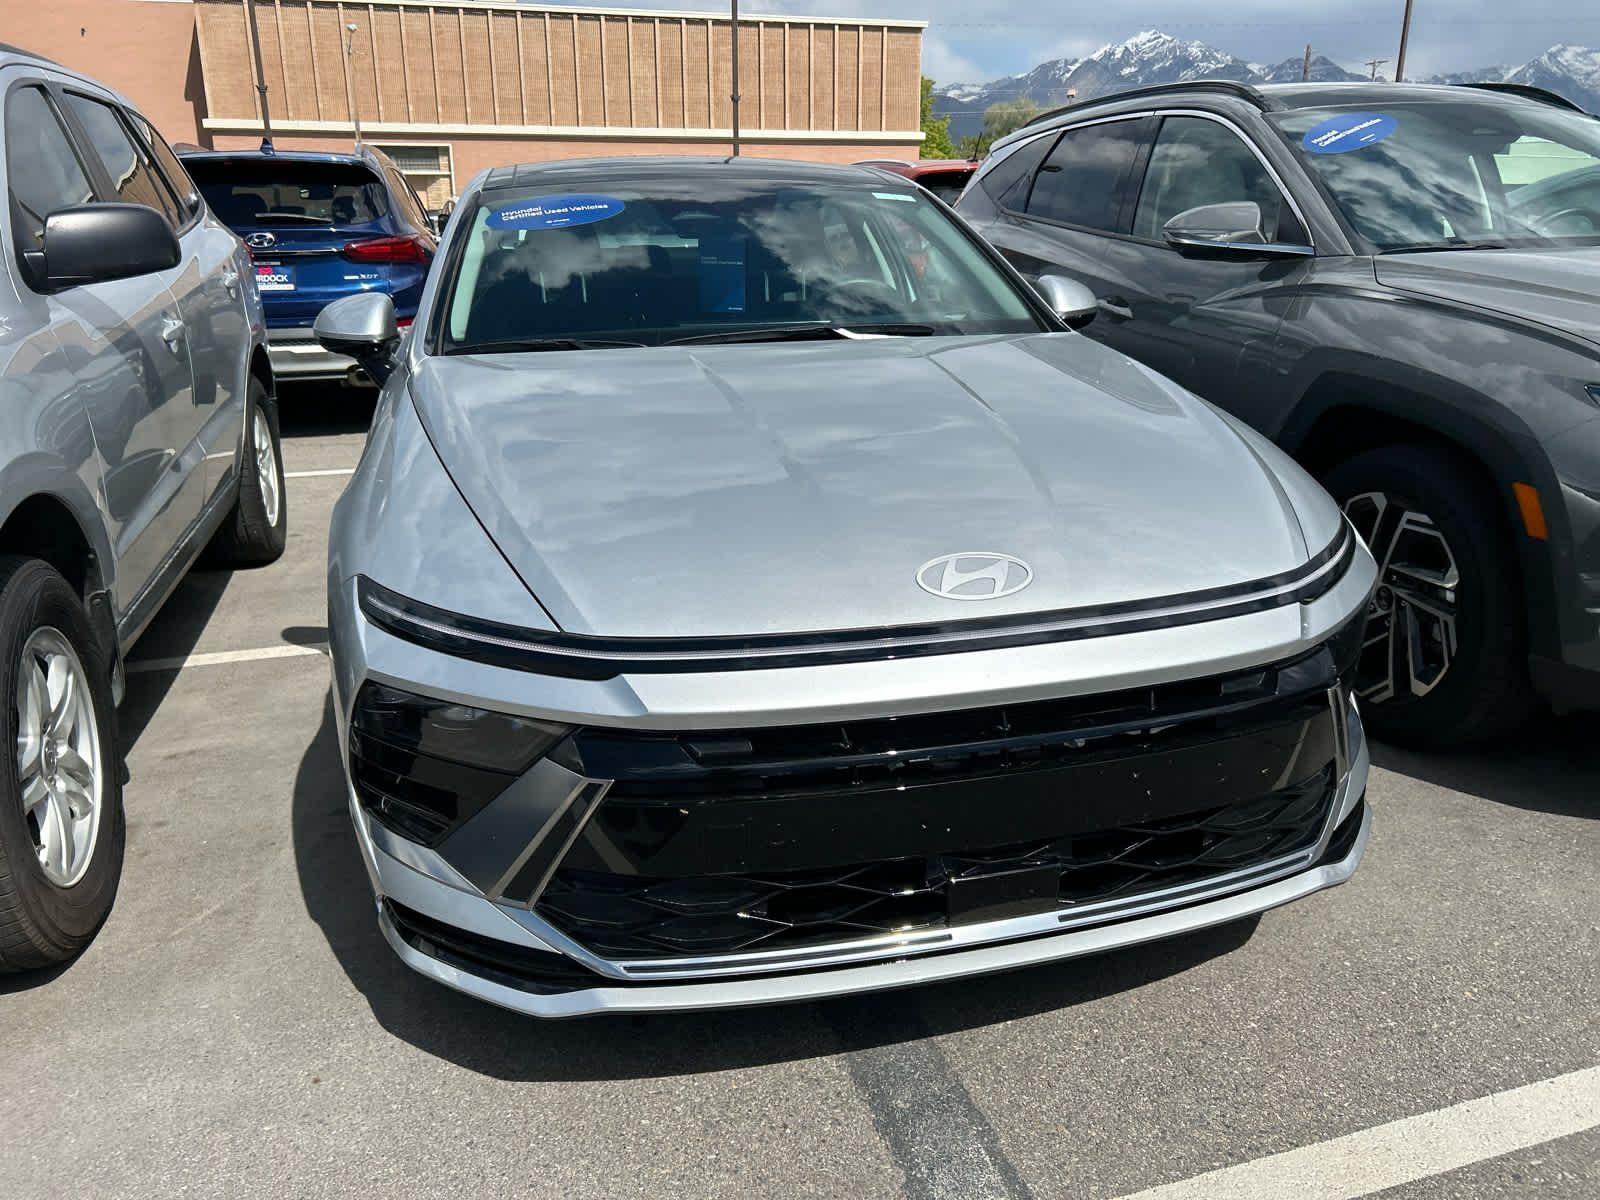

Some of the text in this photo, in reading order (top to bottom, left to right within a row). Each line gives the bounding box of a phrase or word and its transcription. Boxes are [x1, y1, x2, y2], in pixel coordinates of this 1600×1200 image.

[501, 206, 542, 217] Hyundai
[501, 204, 608, 221] Certified Used Vehicles
